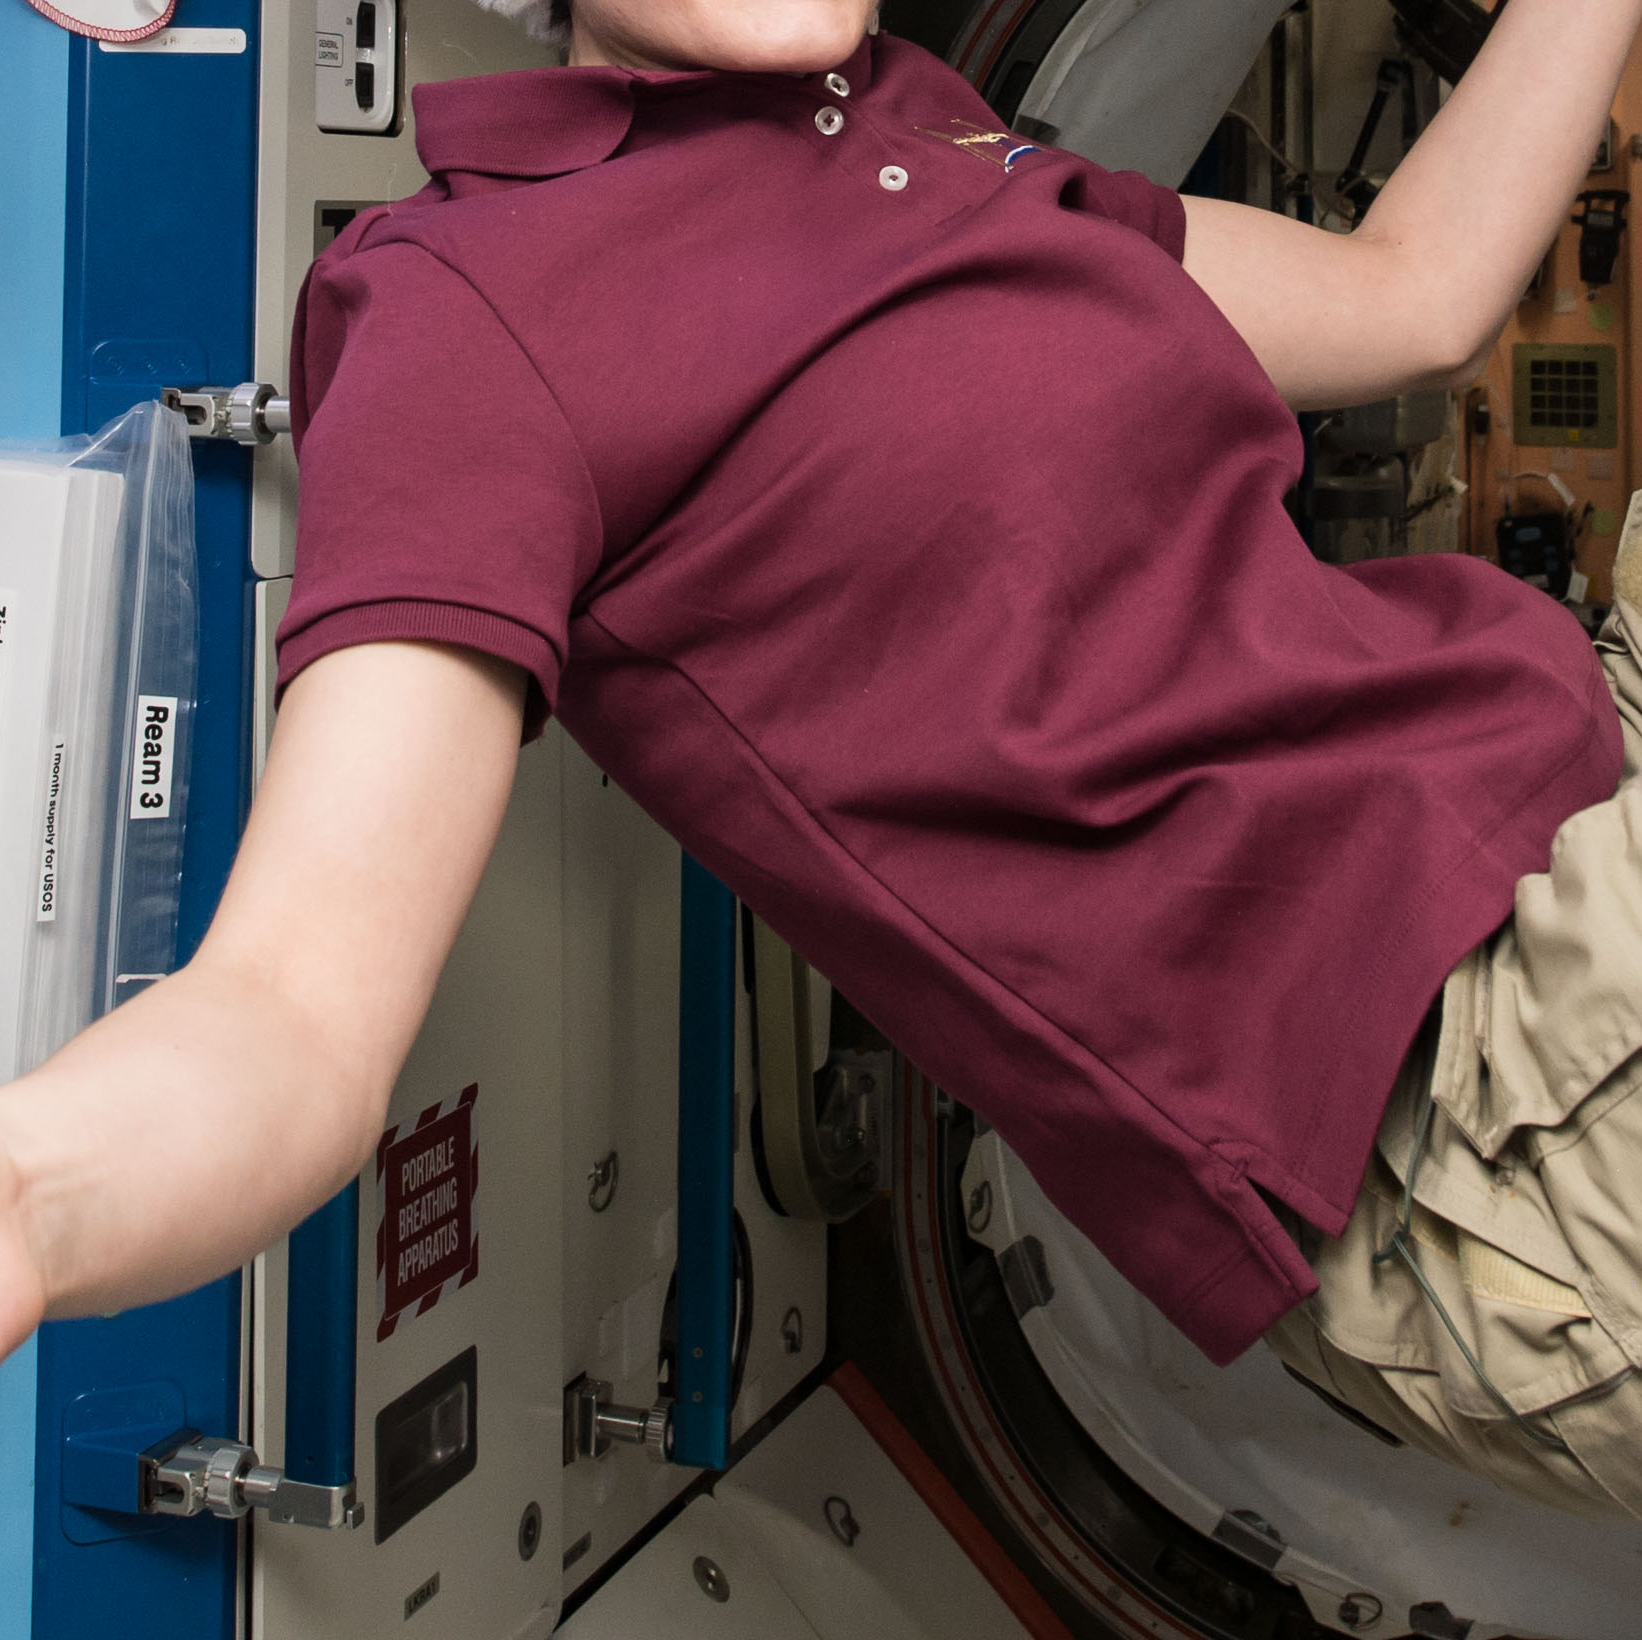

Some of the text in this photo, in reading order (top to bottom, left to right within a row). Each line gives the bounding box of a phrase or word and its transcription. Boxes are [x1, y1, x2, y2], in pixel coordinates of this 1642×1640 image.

[50, 752, 62, 798] month
[140, 704, 169, 810] Ream 3
[45, 802, 58, 846] supply
[45, 848, 55, 871] for
[41, 872, 54, 913] USOS
[401, 1135, 455, 1197] PORTABLE
[398, 1177, 458, 1243] BREATHING
[397, 1218, 459, 1287] APPARATUS
